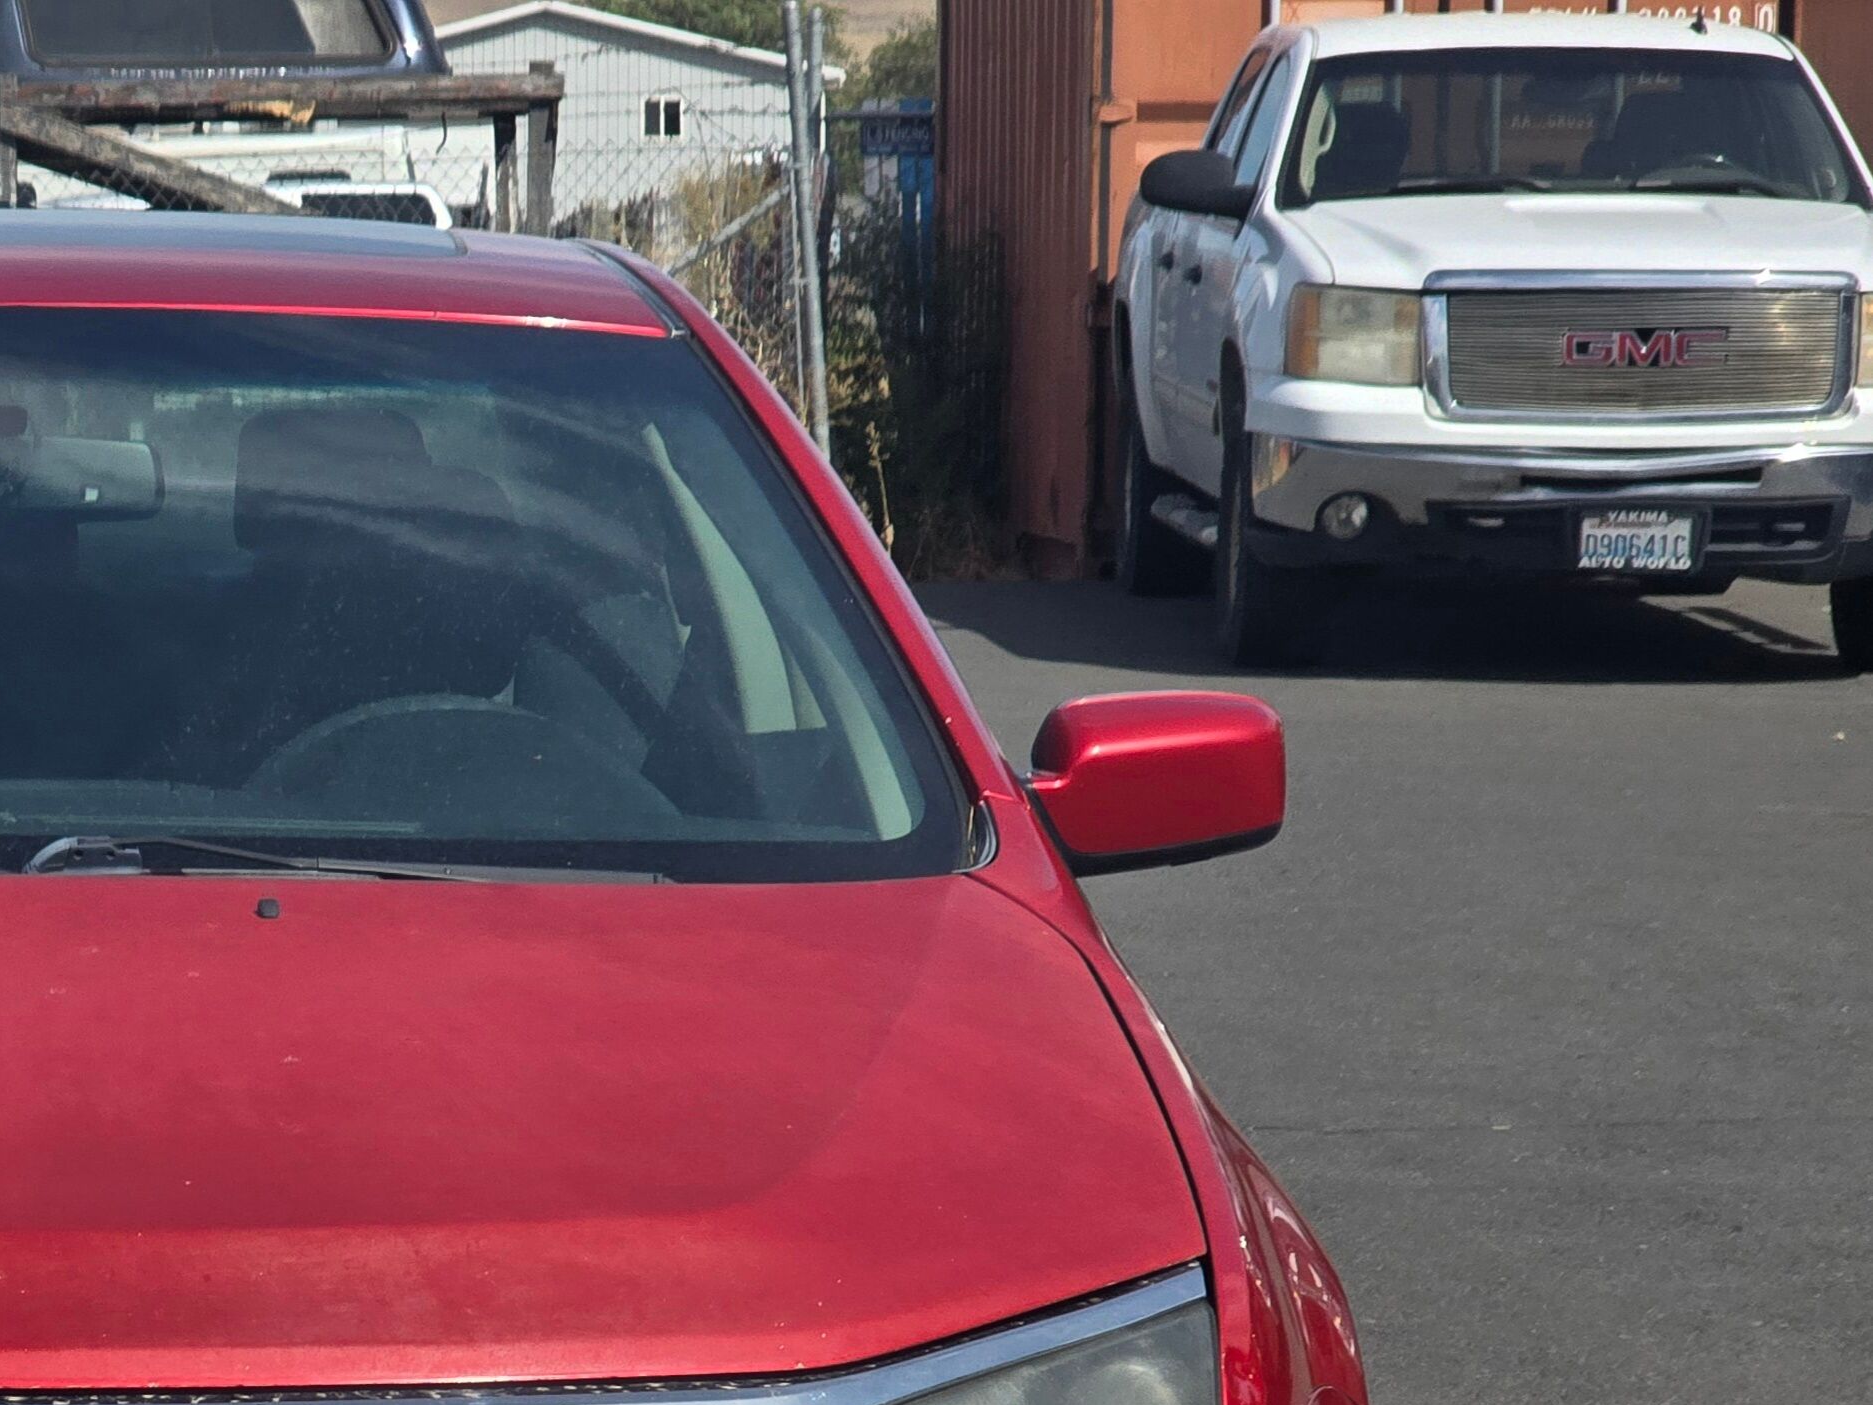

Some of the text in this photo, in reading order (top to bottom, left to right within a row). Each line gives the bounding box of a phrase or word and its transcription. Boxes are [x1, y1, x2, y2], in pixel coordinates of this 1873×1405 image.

[1564, 330, 1729, 367] GMC
[1608, 510, 1668, 523] YAKIMA
[1578, 555, 1692, 570] AUTO WORLD
